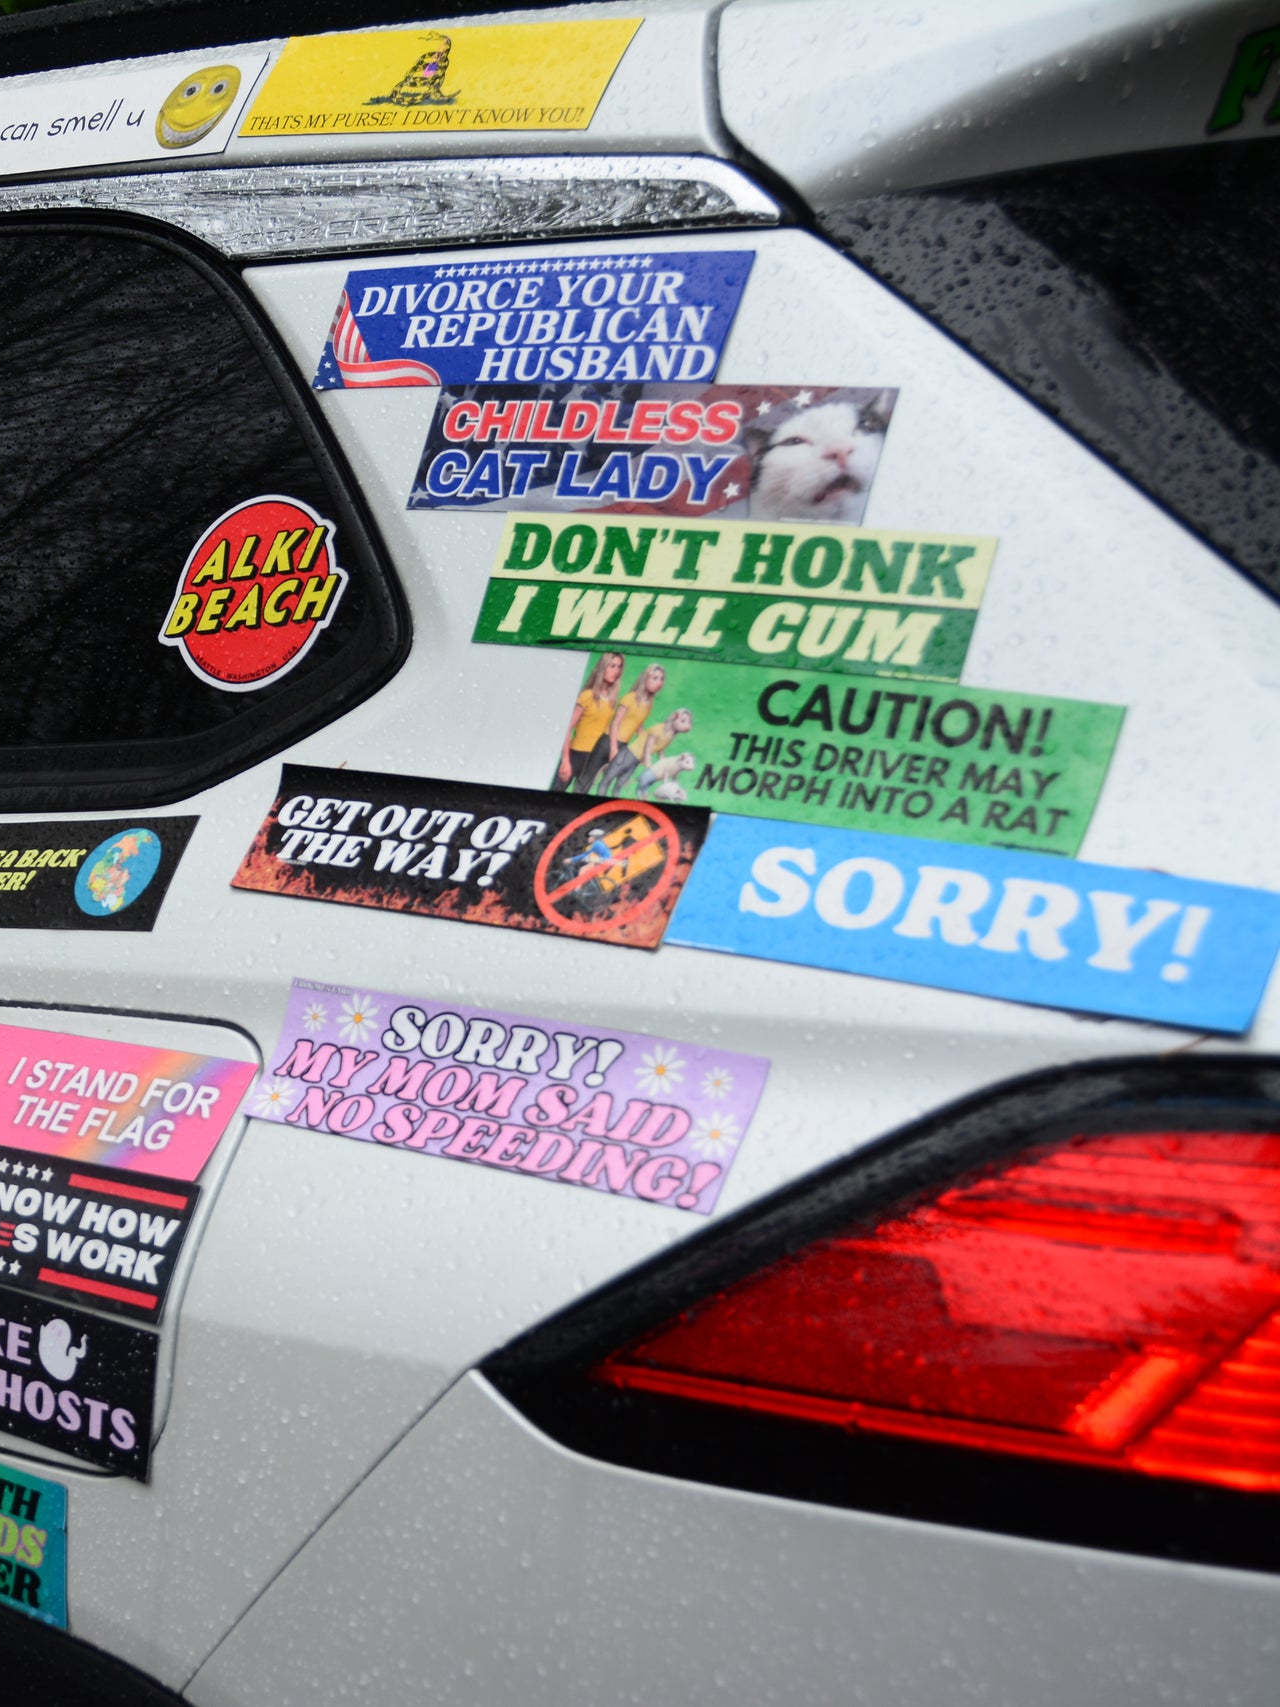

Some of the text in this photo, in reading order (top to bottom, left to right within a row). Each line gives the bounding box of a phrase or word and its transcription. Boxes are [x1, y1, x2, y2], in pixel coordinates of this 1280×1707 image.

[0, 118, 40, 143] can
[53, 97, 124, 135] smell
[126, 109, 146, 130] u
[250, 106, 585, 131] THATS MY PURSE! I DON'T KNOW YOU!
[356, 271, 684, 317] DIVORCE YOUR
[401, 307, 714, 349] REPUBLICAN
[475, 345, 716, 382] HUSBAND
[441, 400, 743, 443] CHILDLESS
[425, 448, 736, 504] CAT LADY
[191, 525, 328, 587] ALKI
[503, 522, 977, 600] DON'T HONK
[164, 573, 342, 637] BEACH
[497, 584, 942, 666] I WILL CUM
[196, 654, 221, 677] SEATTLE
[227, 662, 277, 680] WASHINGTON
[756, 680, 1054, 758] CAUTION!
[728, 731, 1062, 802] THIS DRIVER MAY
[276, 794, 546, 852] GET OUT OF
[694, 763, 1070, 839] MORPH INTO A RAT
[17, 849, 87, 867] BACK
[276, 828, 513, 888] THE WAY!
[737, 846, 1212, 983] SORRY!
[382, 1004, 624, 1088] SORRY!
[7, 1056, 220, 1119] I STAND FOR
[274, 1039, 692, 1148] MY MOM SAID
[13, 1094, 175, 1151] THE FLAG
[285, 1086, 723, 1210] NO SPEEDING!
[78, 1200, 181, 1247] HOW
[44, 1229, 165, 1286] WORK
